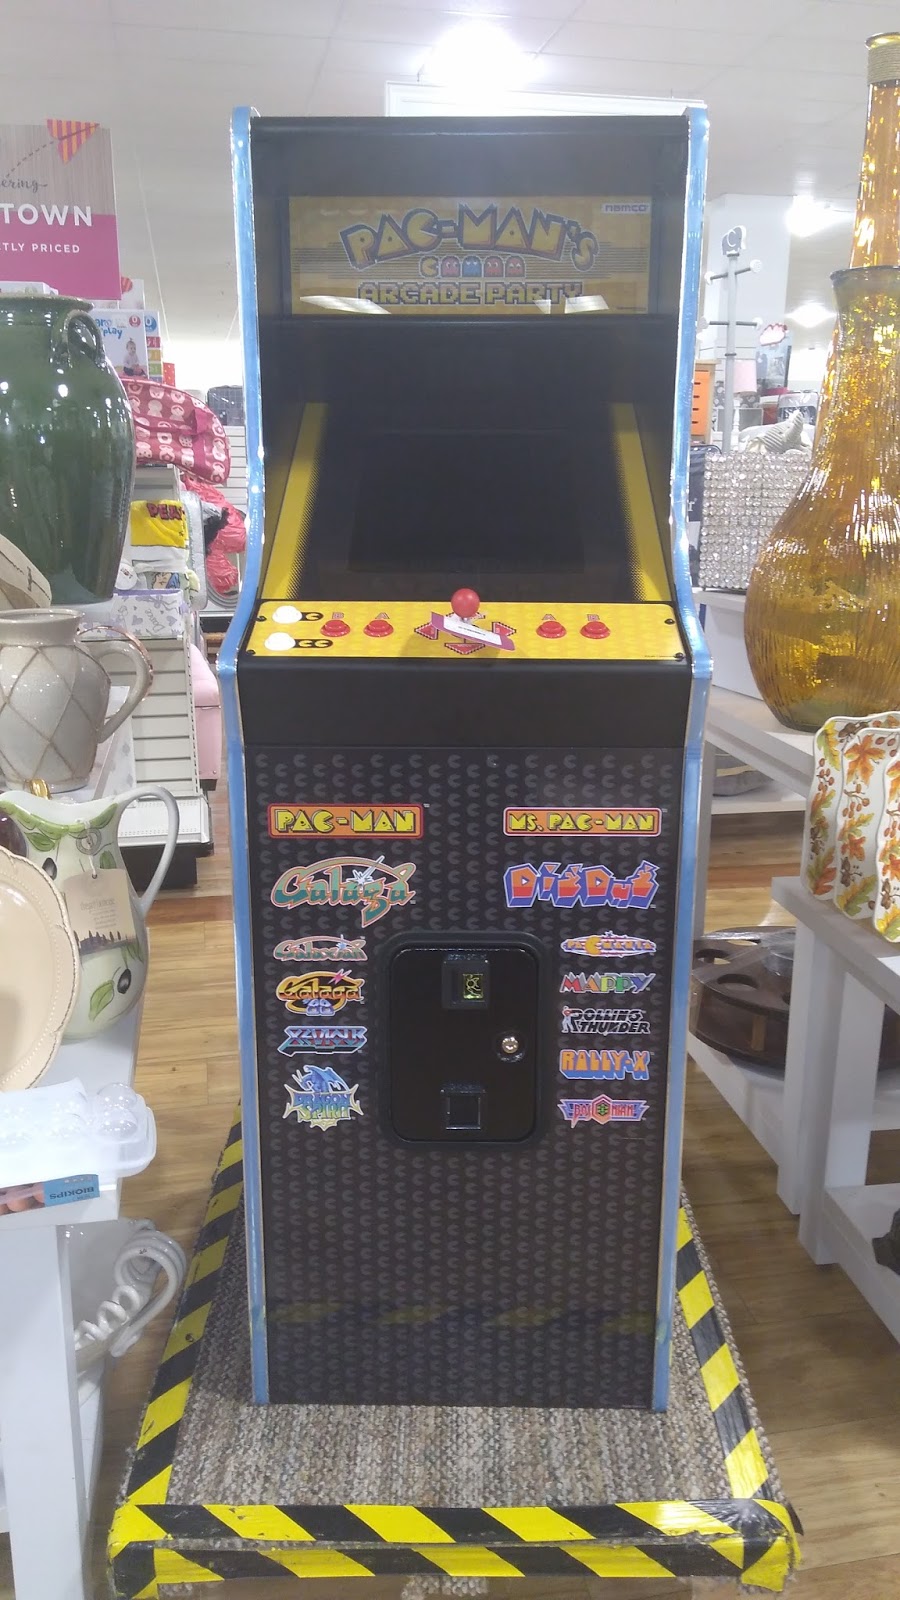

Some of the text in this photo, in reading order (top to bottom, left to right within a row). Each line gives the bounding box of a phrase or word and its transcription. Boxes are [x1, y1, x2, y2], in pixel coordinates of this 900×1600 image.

[0, 203, 92, 227] TOWN
[0, 242, 80, 253] TLY PRICED
[357, 281, 584, 305] ARCADE PARTY
[275, 809, 416, 833] PAC-MAN
[509, 813, 655, 832] MS. PAC-MAN
[271, 856, 416, 928] Galaga
[560, 972, 656, 993] MAPPY
[569, 1008, 645, 1025] ROLLING
[577, 1021, 650, 1034] THUNDER
[560, 1050, 649, 1080] RALLY-X
[49, 1186, 95, 1200] BIOKIPS
